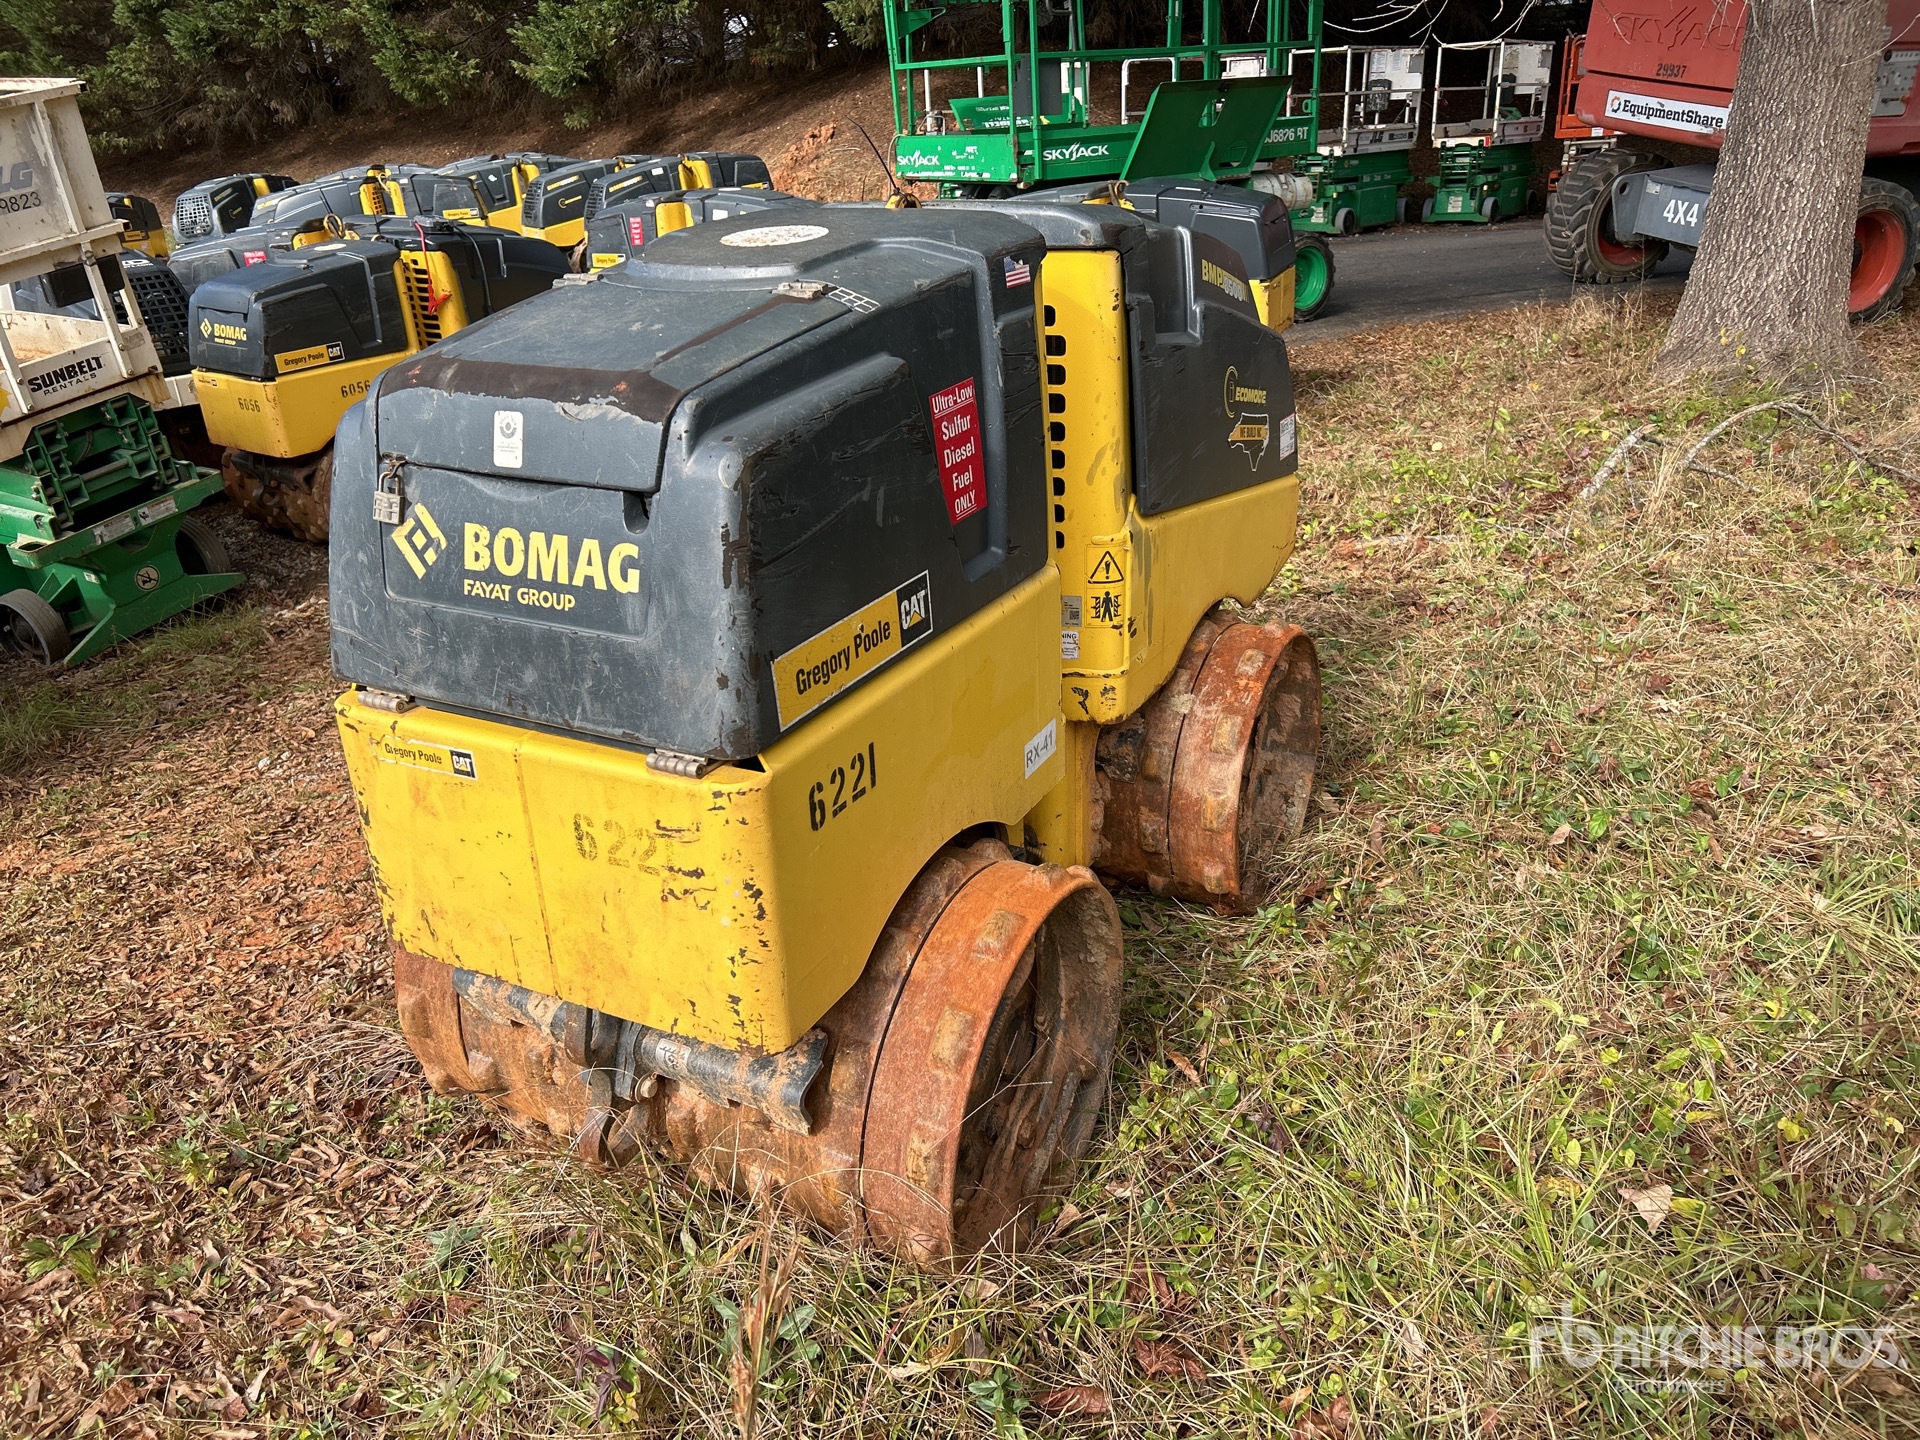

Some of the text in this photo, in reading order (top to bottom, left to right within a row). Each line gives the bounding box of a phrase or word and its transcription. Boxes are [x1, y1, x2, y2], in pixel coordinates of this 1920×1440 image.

[1655, 63, 1687, 78] 29937
[1622, 98, 1724, 128] EquipmentShare
[1265, 127, 1295, 144] J6826
[897, 149, 940, 168] SKYJACK
[1043, 142, 1110, 161] SKYJACK
[1663, 199, 1699, 227] 4X4
[213, 323, 247, 341] BOMAG
[284, 346, 341, 366] Gregory Poole CAT
[27, 356, 103, 393] SUNBELT
[43, 372, 97, 396] RENTALS
[341, 379, 371, 399] 6056
[932, 385, 973, 414] Ultra-Low
[238, 397, 261, 413] 6056
[941, 414, 971, 441] Sulfur
[943, 436, 975, 468] Diesel
[952, 465, 973, 492] Fuel
[954, 490, 976, 514] ONLY
[464, 522, 641, 594] BOMAG
[463, 579, 576, 612] FAYAT GROUP
[900, 589, 927, 630] CAT
[795, 619, 891, 696] Gregory Poole
[385, 743, 416, 761] Gregory
[452, 755, 472, 772] CAT
[1026, 729, 1054, 768] RX-41
[808, 741, 877, 832] 6221
